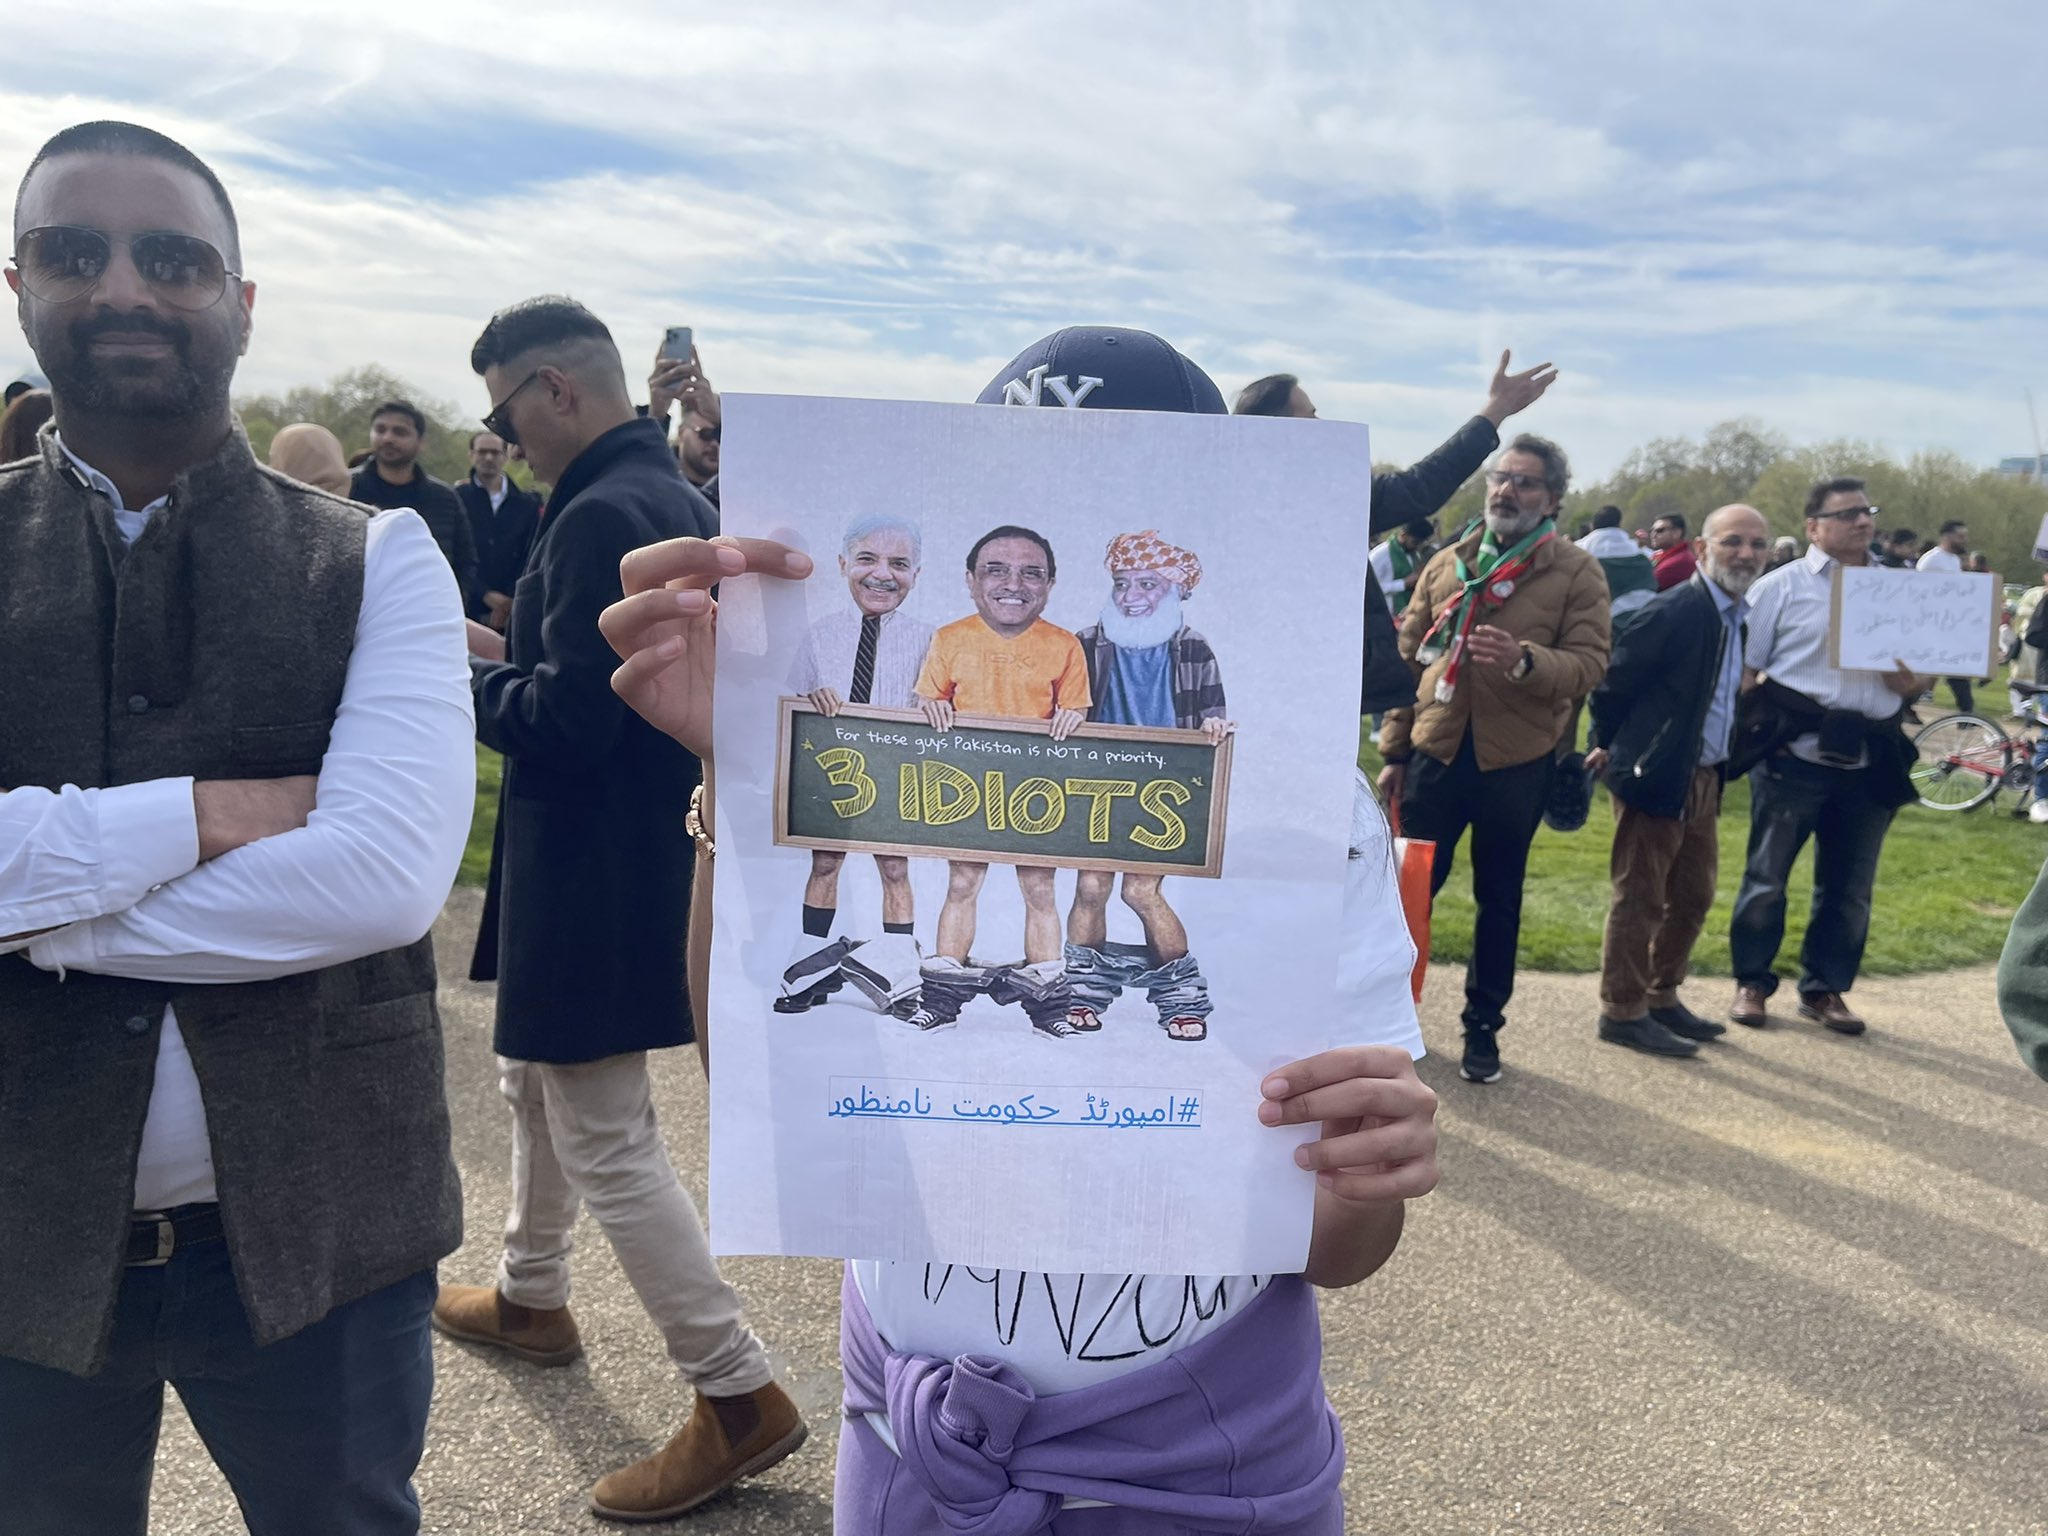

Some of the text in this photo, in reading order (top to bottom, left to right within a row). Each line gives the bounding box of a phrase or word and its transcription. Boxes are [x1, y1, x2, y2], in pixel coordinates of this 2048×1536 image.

[1002, 363, 1104, 407] NY
[834, 727, 1167, 770] For these guys Pakistan is NOT a priority.
[815, 747, 1191, 851] 3 IDIOTS
[828, 1084, 931, 1118] نامنظور
[953, 1094, 1060, 1125] حکومت
